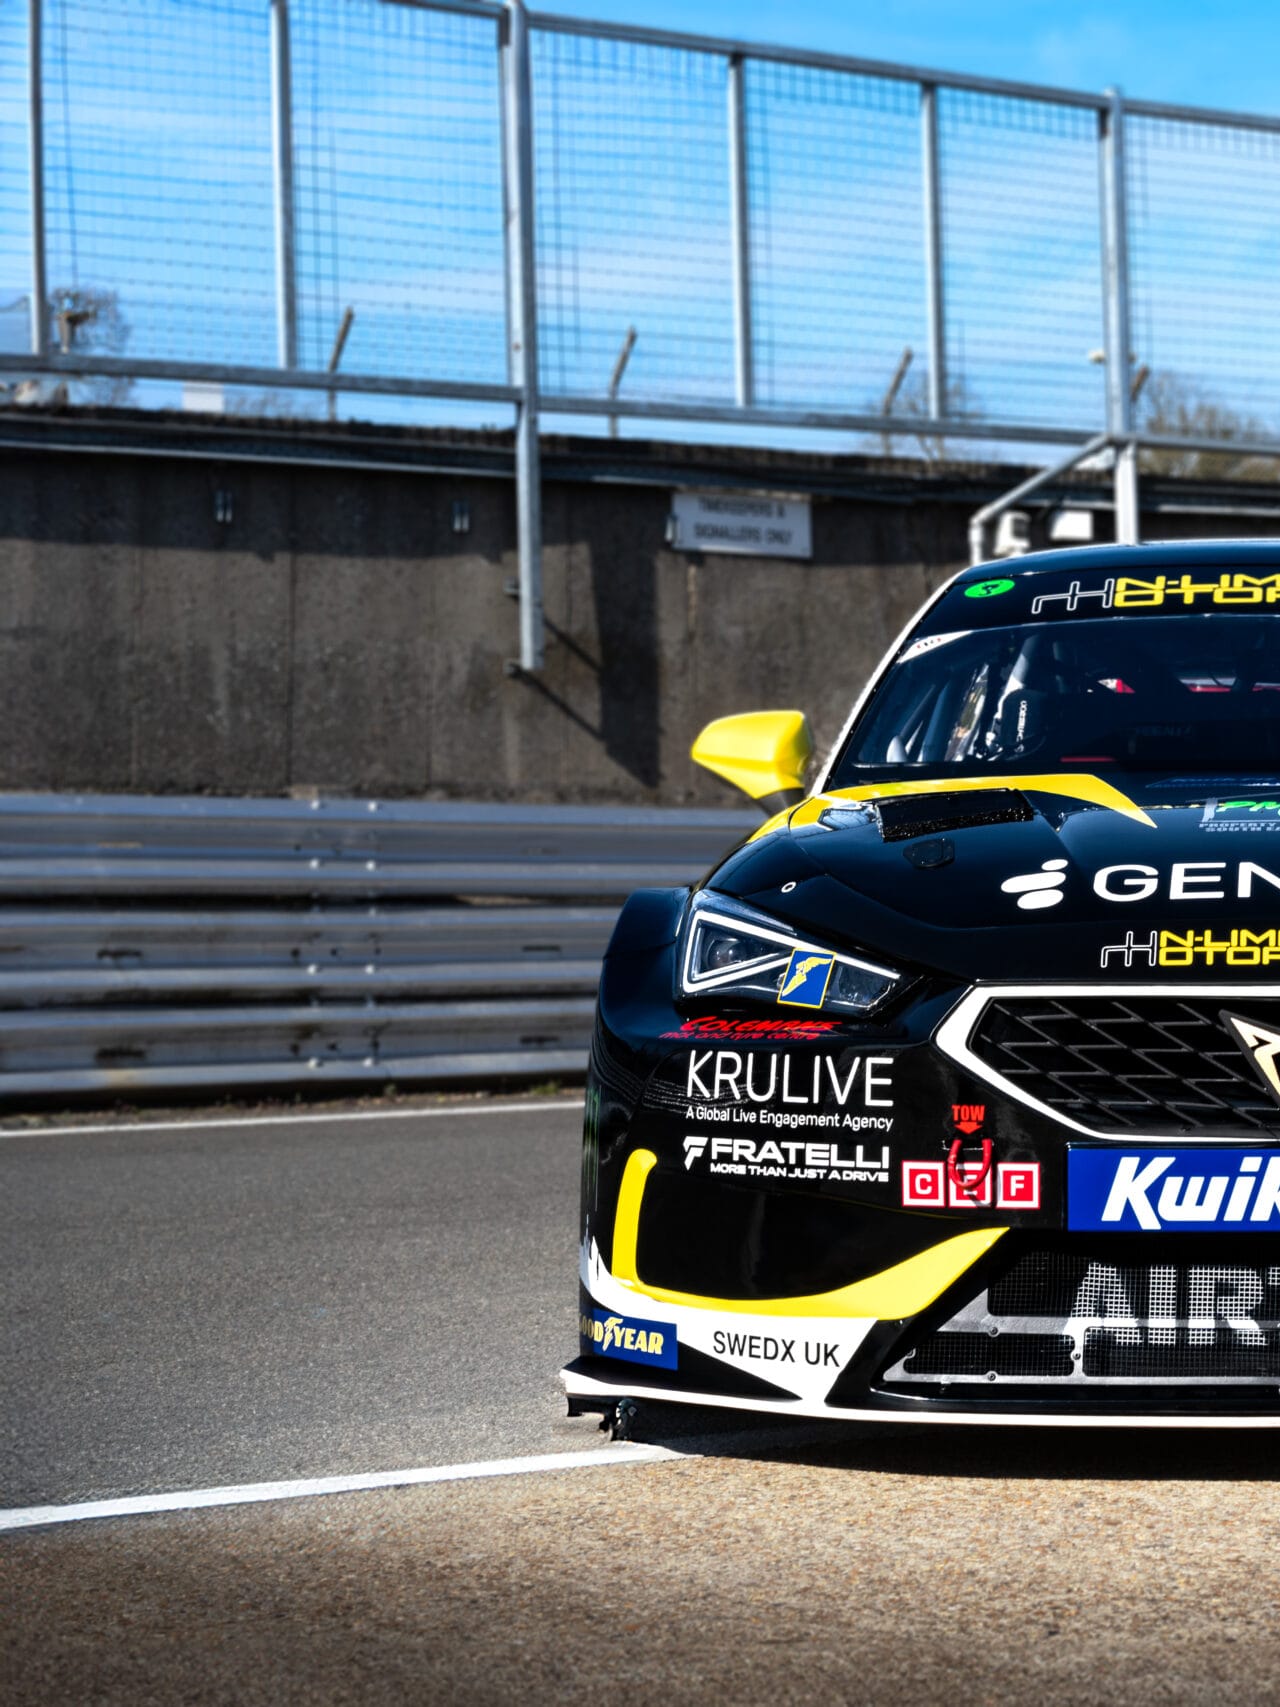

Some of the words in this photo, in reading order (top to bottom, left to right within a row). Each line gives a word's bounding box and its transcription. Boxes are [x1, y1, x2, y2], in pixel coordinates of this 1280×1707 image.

[686, 1049, 894, 1107] KRULIVE
[685, 1106, 695, 1120] A
[696, 1106, 731, 1122] Global
[732, 1108, 757, 1123] Live
[759, 1109, 840, 1129] Engagement
[842, 1113, 894, 1132] Agency
[951, 1104, 986, 1122] TOW
[711, 1137, 890, 1169] FRATELLI
[710, 1162, 747, 1174] MORE
[748, 1165, 787, 1177] THAN
[788, 1168, 827, 1179] JUST
[828, 1170, 842, 1180] A
[842, 1170, 889, 1182] DRIVE
[579, 1313, 665, 1355] OODYEAR
[712, 1330, 796, 1363] SWEDX
[803, 1340, 841, 1367] UK
